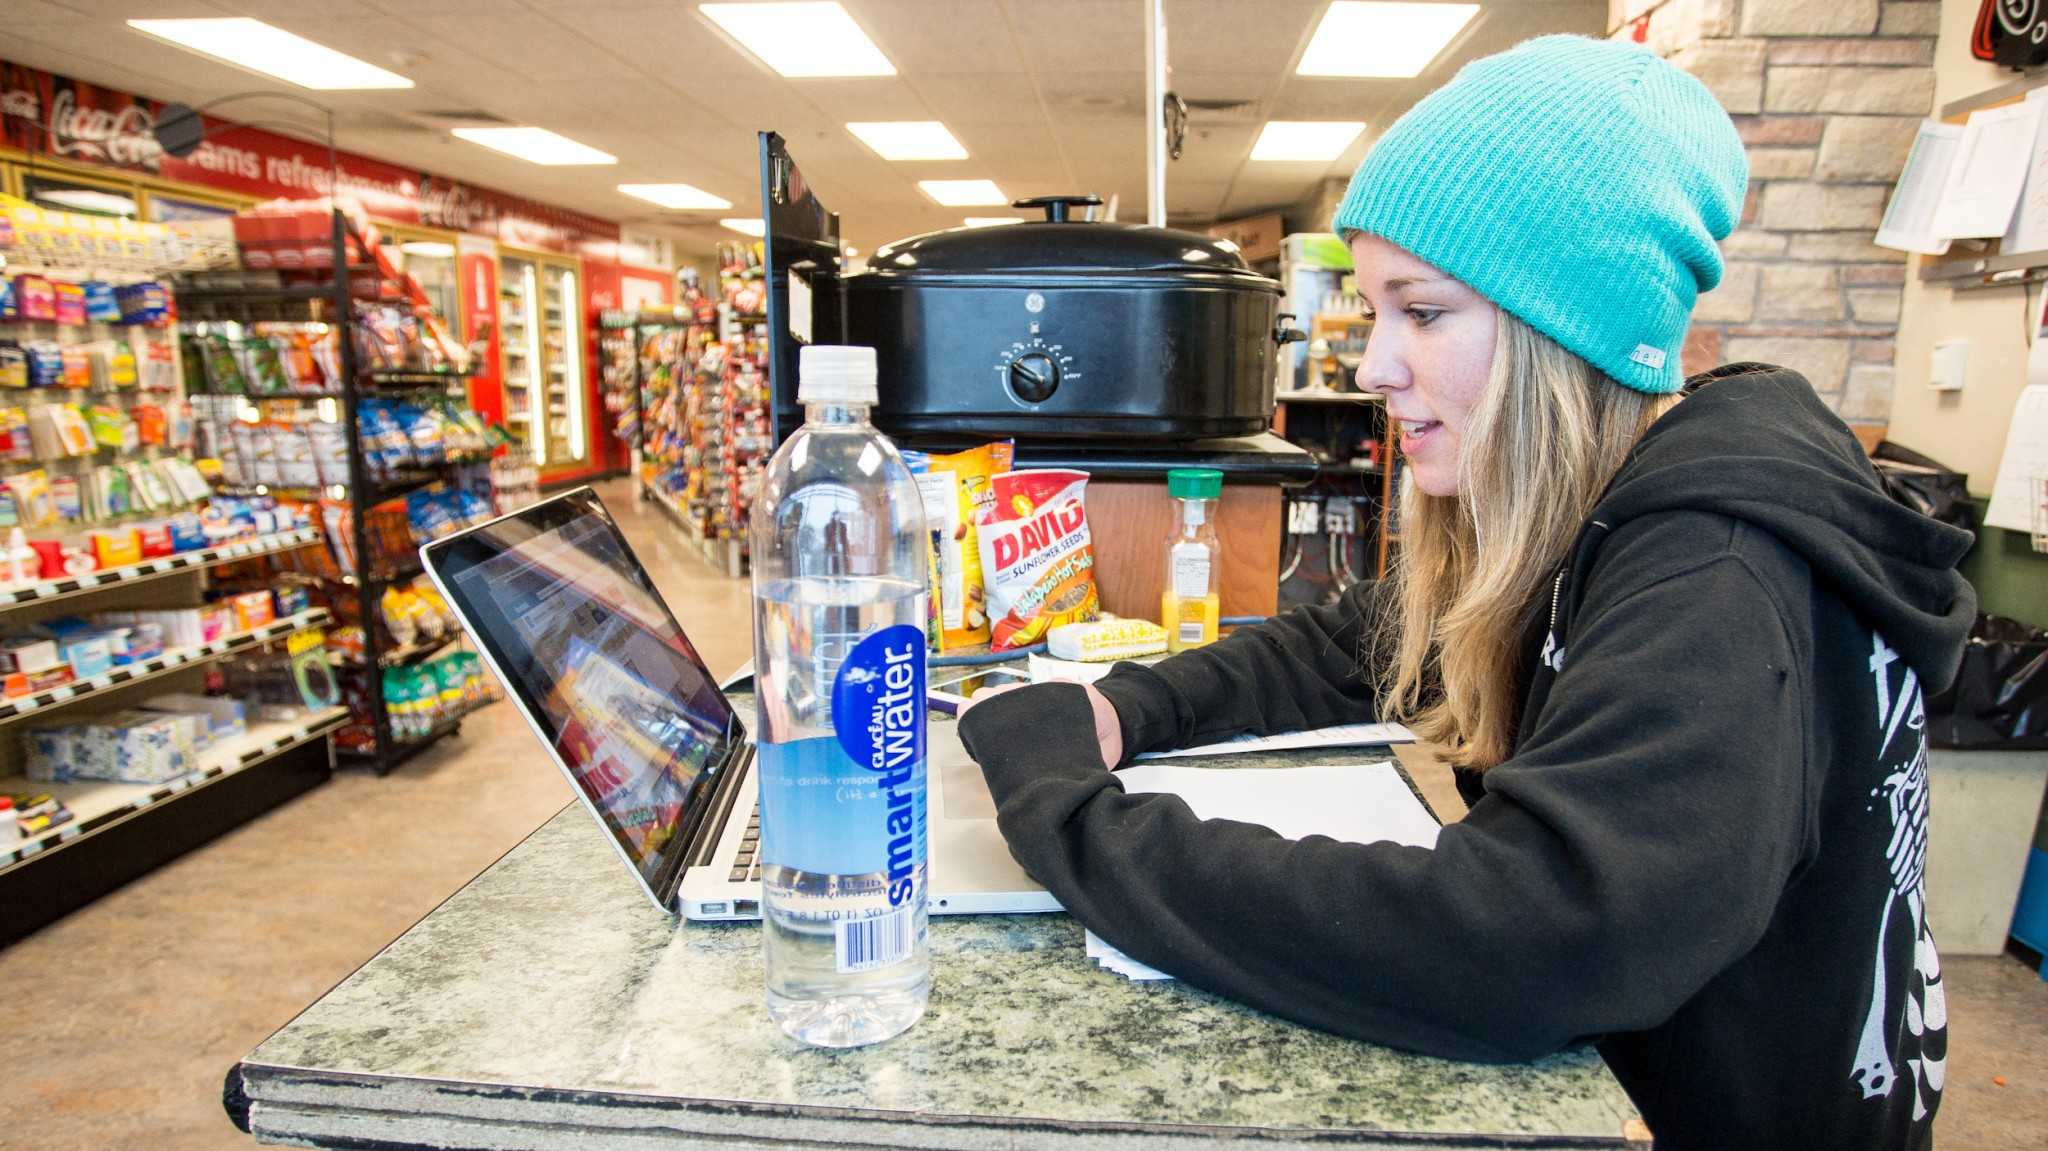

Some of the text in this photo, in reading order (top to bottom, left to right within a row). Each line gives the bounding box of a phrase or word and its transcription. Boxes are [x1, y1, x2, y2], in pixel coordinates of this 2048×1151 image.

[992, 498, 1084, 573] DAVID
[1012, 532, 1085, 578] SUNFLOWER SEEDS
[867, 705, 886, 769] GLACÉAU
